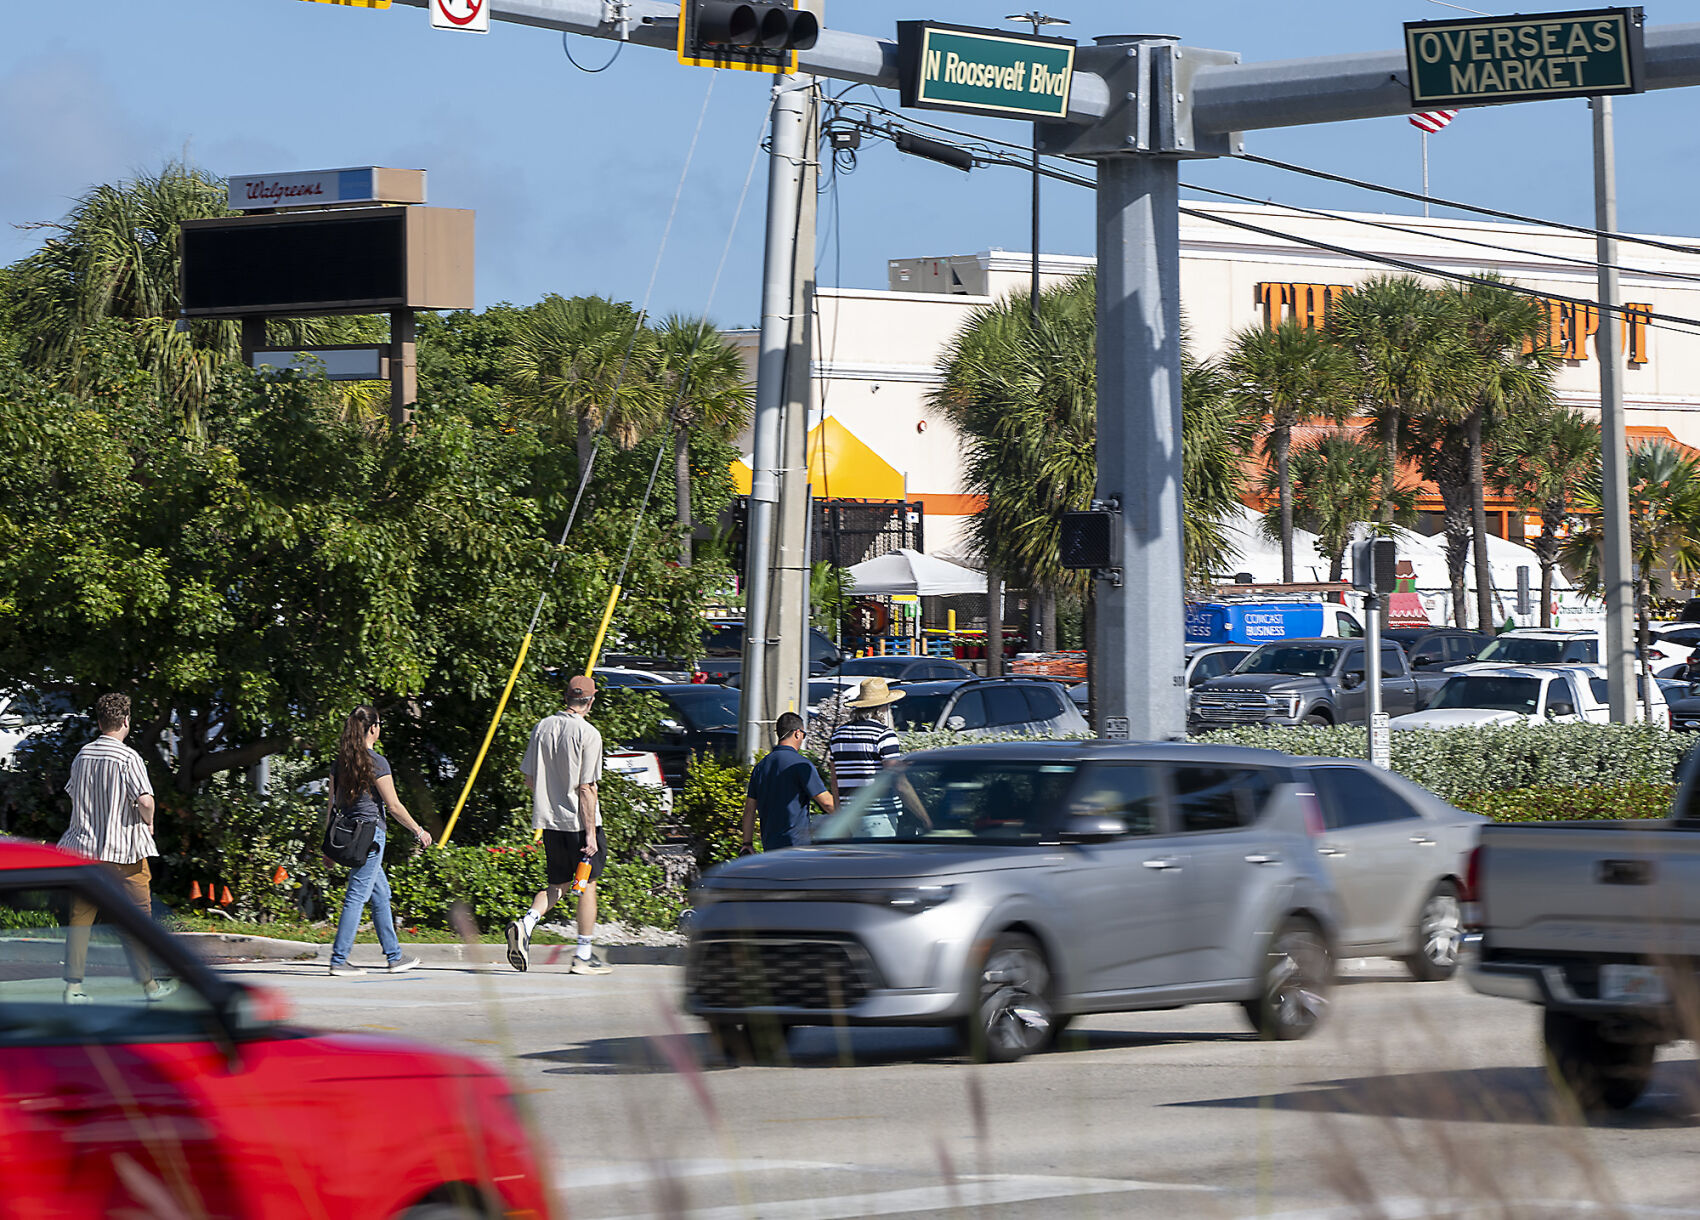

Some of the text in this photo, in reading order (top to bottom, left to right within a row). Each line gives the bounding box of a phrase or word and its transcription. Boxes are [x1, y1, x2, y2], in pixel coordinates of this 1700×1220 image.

[1420, 21, 1616, 64] OVERSEAS
[925, 49, 1068, 97] N Roosevelt Blvd
[1449, 56, 1588, 94] MARKET
[245, 180, 324, 204] Walgreens
[1244, 613, 1284, 625] COMCAST
[1245, 625, 1286, 636] BUSINESS
